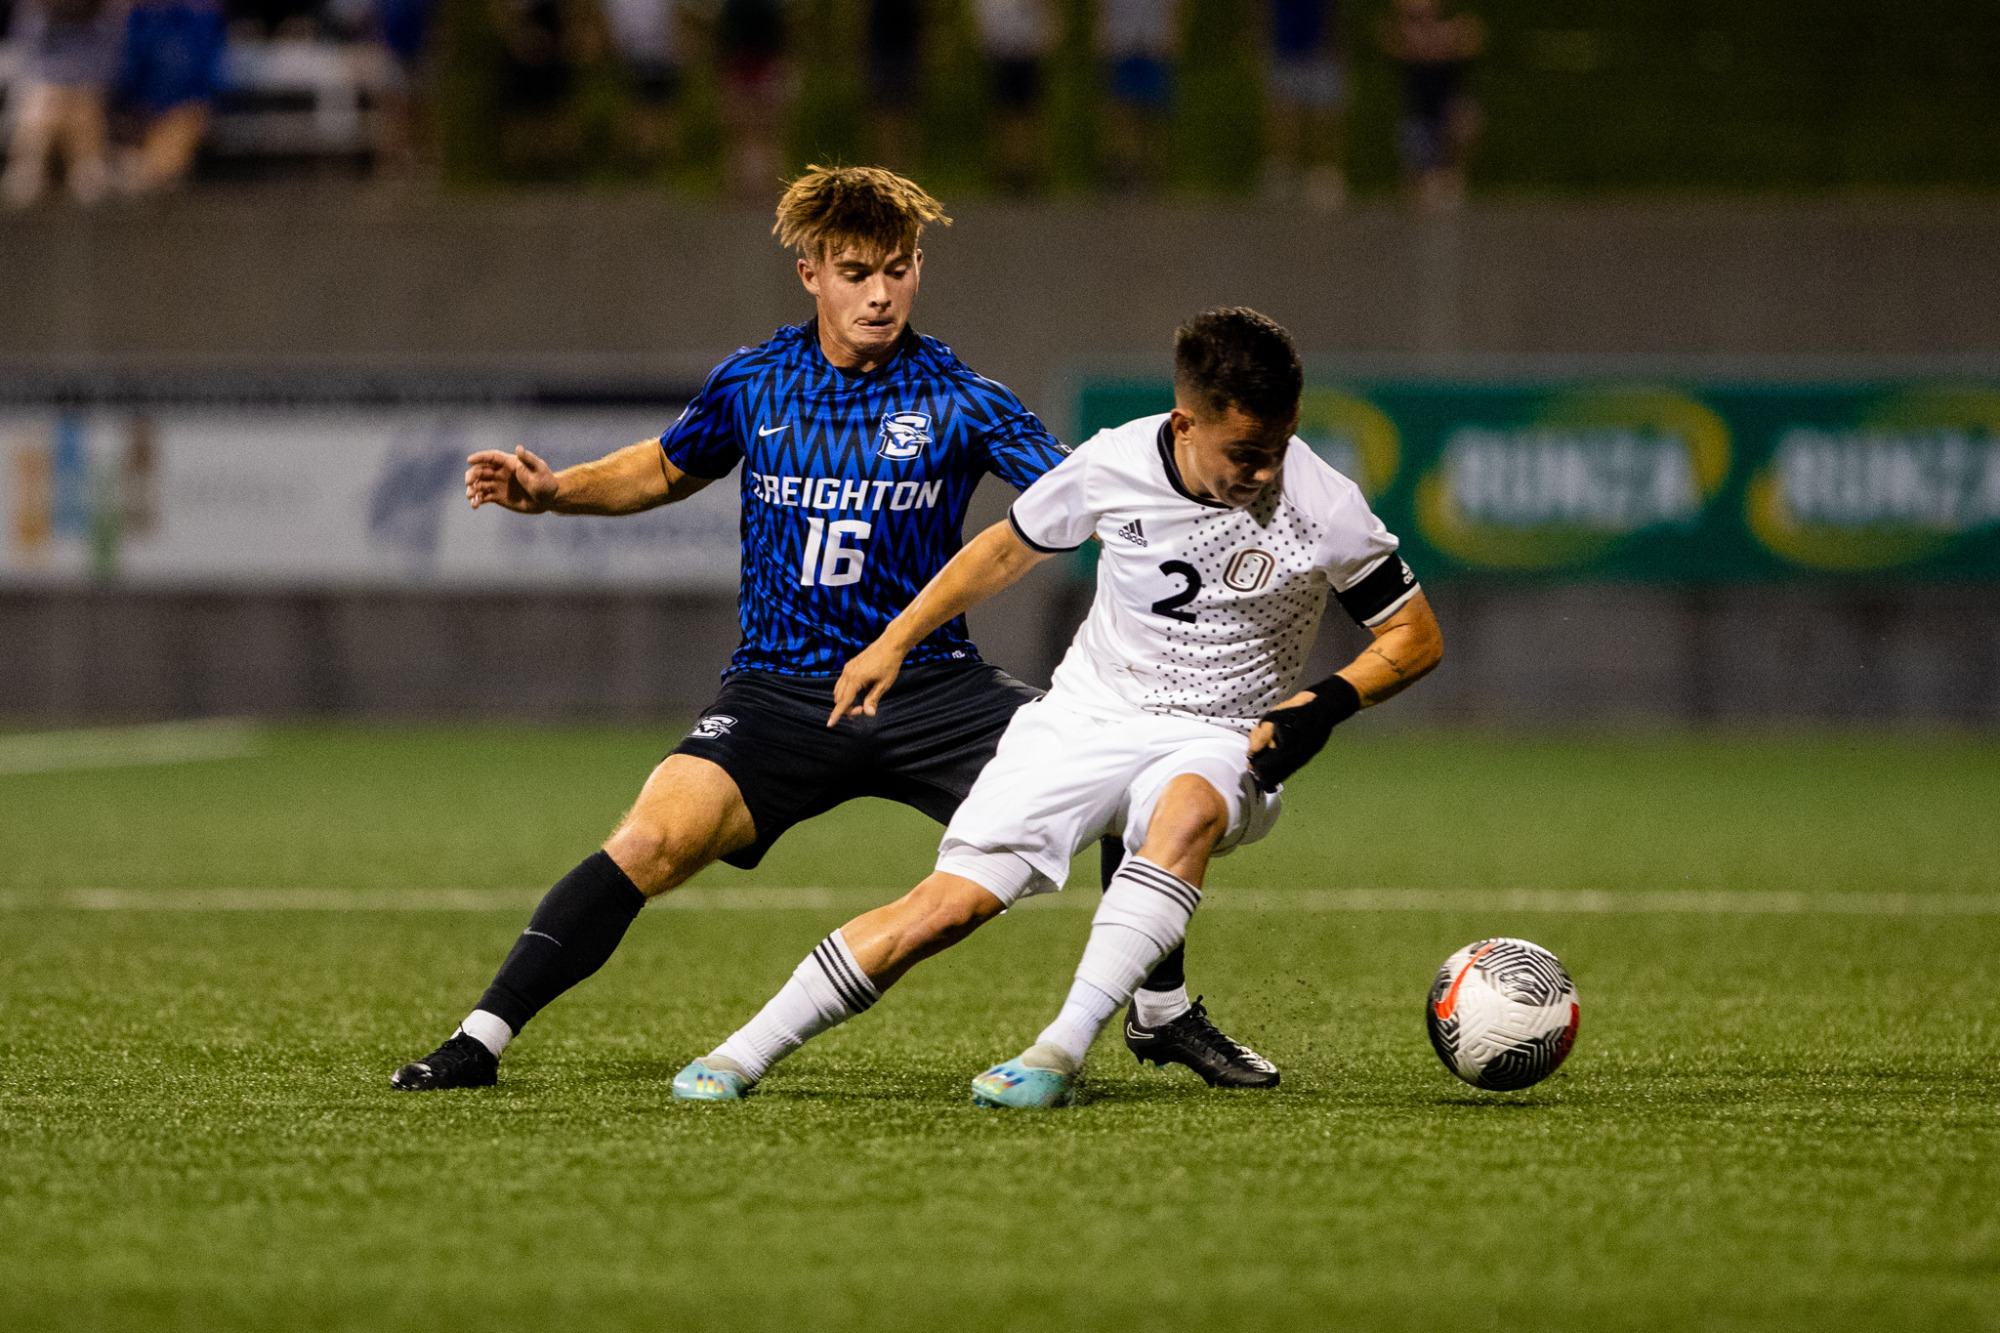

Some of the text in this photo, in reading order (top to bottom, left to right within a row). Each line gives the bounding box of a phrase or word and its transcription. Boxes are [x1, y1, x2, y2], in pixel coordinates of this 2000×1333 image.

[752, 472, 943, 511] CREIGHTON
[801, 517, 872, 586] 16
[1118, 528, 1148, 547] adidas
[1151, 559, 1202, 624] 2
